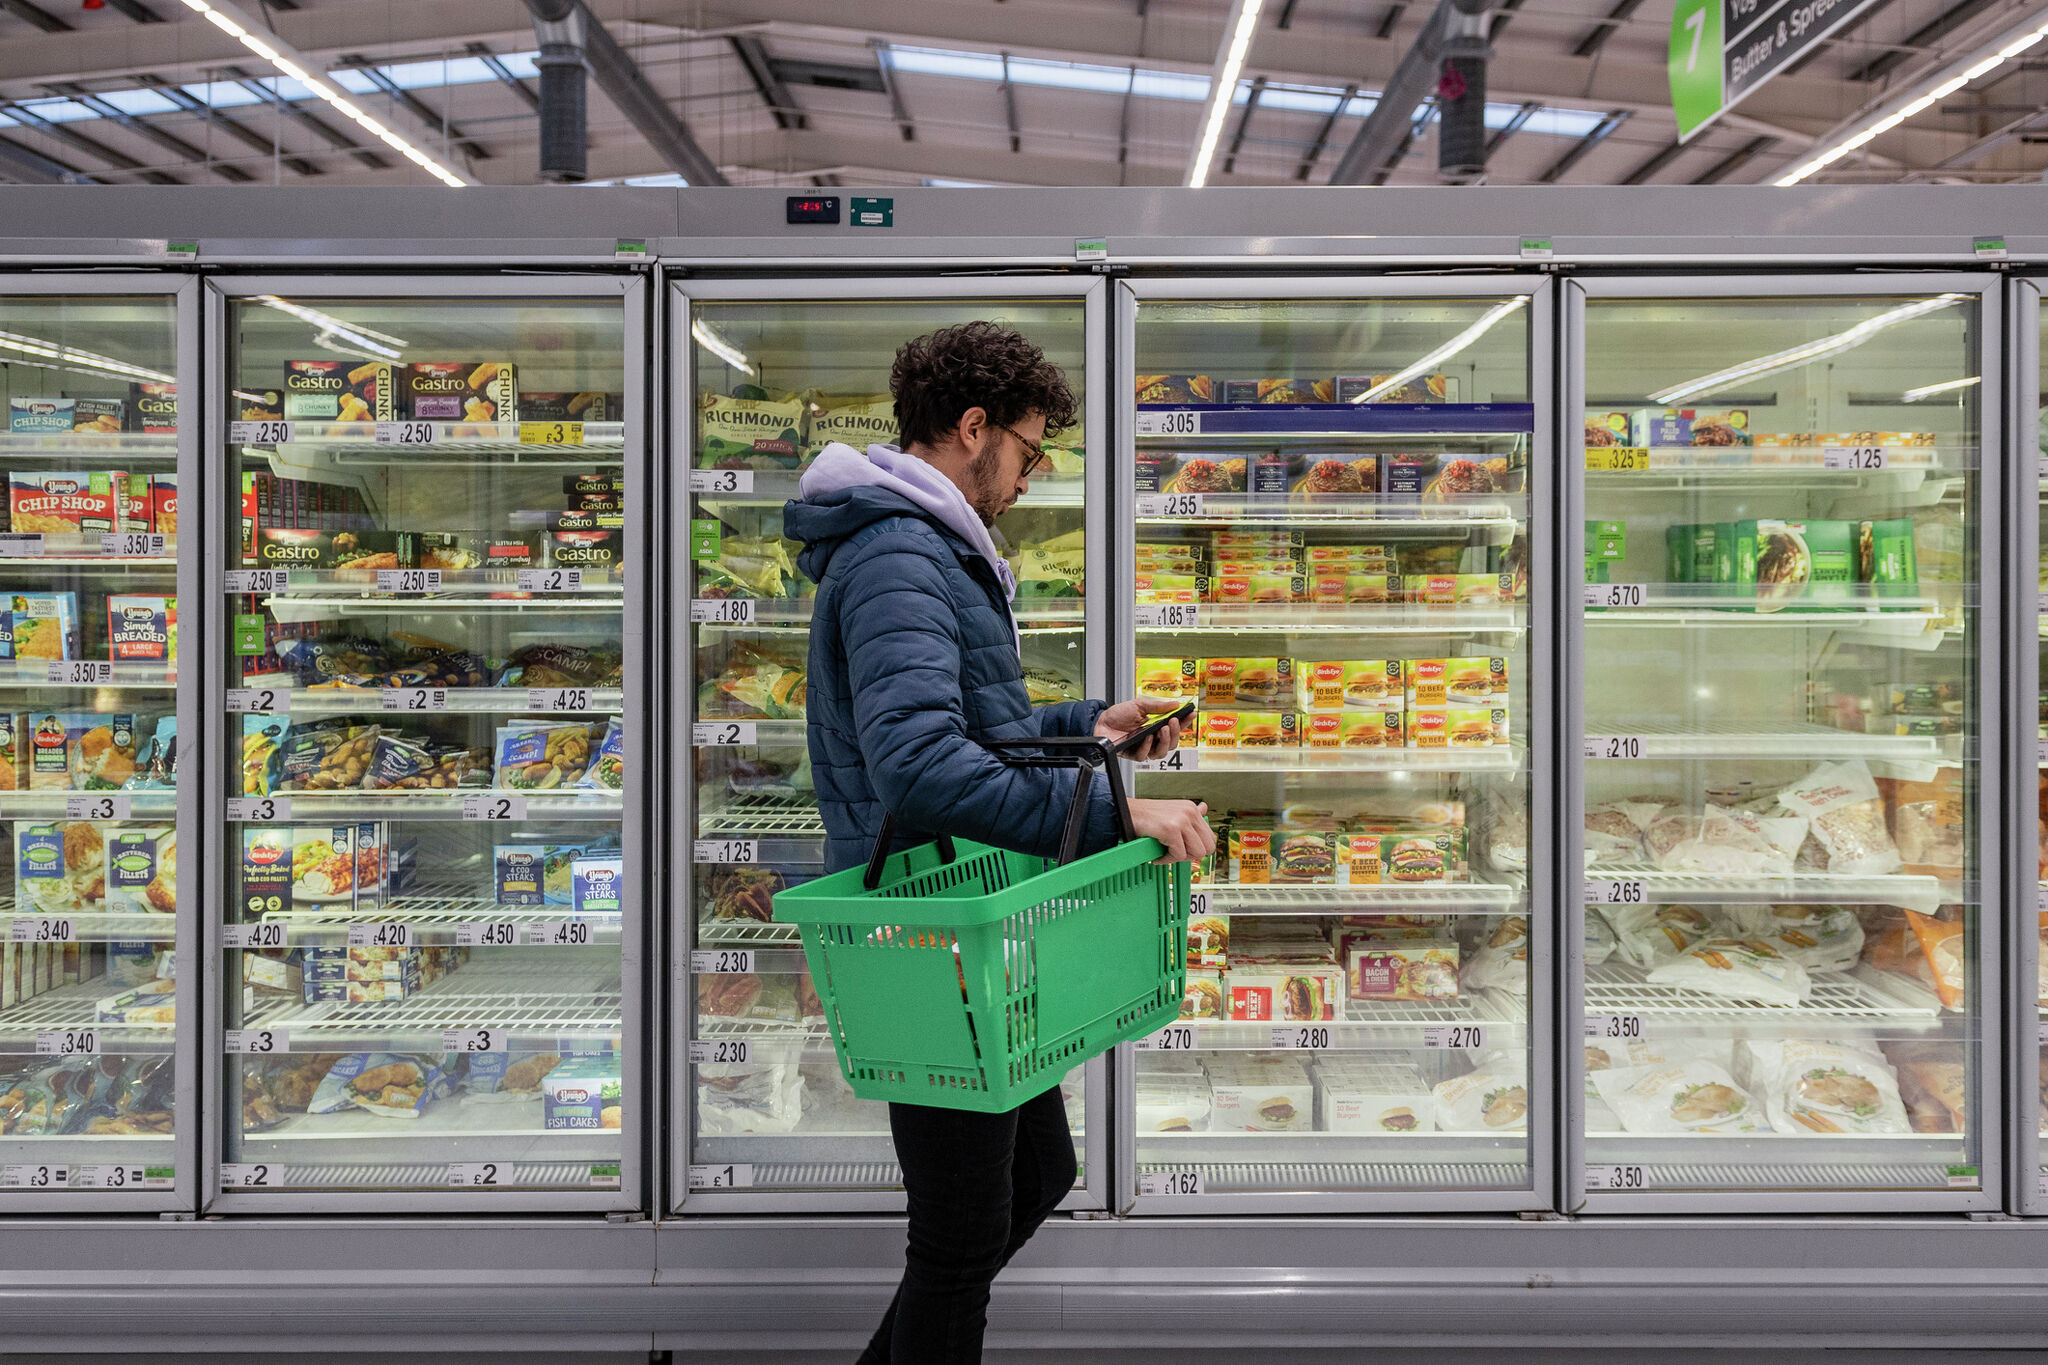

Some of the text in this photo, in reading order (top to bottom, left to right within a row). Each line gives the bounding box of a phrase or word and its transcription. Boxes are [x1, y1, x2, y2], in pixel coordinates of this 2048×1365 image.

[1684, 7, 1706, 73] 7
[1730, 35, 1776, 81] Butter
[1776, 21, 1789, 48] &
[288, 374, 343, 389] Gastro
[412, 377, 465, 391] Gastro
[13, 417, 71, 429] CHIP SHOP
[704, 410, 795, 429] RICHMOND
[1161, 413, 1195, 433] £3.05
[256, 422, 288, 443] £2.50
[399, 422, 432, 443] £2.50
[546, 424, 564, 444] £3
[755, 441, 767, 449] 20
[575, 482, 608, 491] Gastro
[714, 471, 737, 492] £3
[17, 497, 106, 512] CHIP SHOP
[580, 501, 613, 510] Gastro
[1164, 495, 1197, 515] £2.55
[558, 518, 592, 528] Gastro
[123, 534, 149, 555] £3.50
[263, 543, 320, 560] Gastro
[555, 546, 612, 560] Gastro
[247, 571, 272, 592] £2.50
[400, 571, 424, 591] £2.50
[544, 571, 562, 590] £2
[1607, 585, 1640, 606] £5.70
[715, 600, 748, 621] £1.80
[1157, 605, 1182, 626] £1.85
[123, 621, 155, 633] Simply
[114, 632, 166, 643] BREADED
[121, 645, 129, 656] 4
[537, 649, 592, 674] SCAMPI
[70, 662, 96, 682] £3.50
[250, 690, 275, 711] £2
[408, 690, 427, 710] £2
[553, 689, 586, 710] £4.25
[717, 724, 741, 745] £2
[1217, 738, 1236, 746] BEEF
[508, 751, 539, 762] SCAMPI
[1606, 738, 1639, 758] £2.10
[1160, 750, 1183, 770] £4
[91, 798, 115, 818] £3
[251, 800, 276, 820] £3
[487, 799, 511, 819] £2
[718, 841, 751, 862] £1.25
[29, 861, 57, 871] FILLETS
[119, 869, 149, 880] FILLETS
[244, 864, 291, 875] Perfectly Baked
[516, 866, 530, 874] COD
[505, 873, 535, 881] STEAKS
[589, 883, 611, 891] 4 COD
[585, 890, 617, 900] STEAKS
[1607, 882, 1641, 902] £2.65
[36, 920, 69, 941] £3.40
[248, 924, 281, 946] £4.20
[373, 924, 406, 946] £4.20
[481, 923, 514, 944] £4.50
[554, 923, 587, 944] £4.50
[715, 951, 748, 972] £2.30
[1374, 959, 1381, 967] 4
[1365, 968, 1390, 977] BACON
[1235, 1000, 1246, 1009] 4
[1607, 1016, 1640, 1037] £3.50
[60, 1032, 94, 1053] £3.40
[249, 1031, 274, 1052] £3
[467, 1030, 491, 1051] £3
[1158, 1029, 1191, 1049] £2.70
[1296, 1028, 1328, 1048] £2.80
[1448, 1027, 1481, 1048] £2.70
[713, 1042, 747, 1063] £2.30
[1216, 1101, 1240, 1109] Burgers
[547, 1116, 598, 1128] FISH CAKES
[31, 1166, 48, 1186] £3
[107, 1166, 125, 1187] £3
[244, 1165, 269, 1186] £2
[473, 1163, 497, 1185] £2
[713, 1165, 734, 1187] £1
[1165, 1173, 1198, 1194] £1.62
[1610, 1167, 1643, 1187] £3.50
